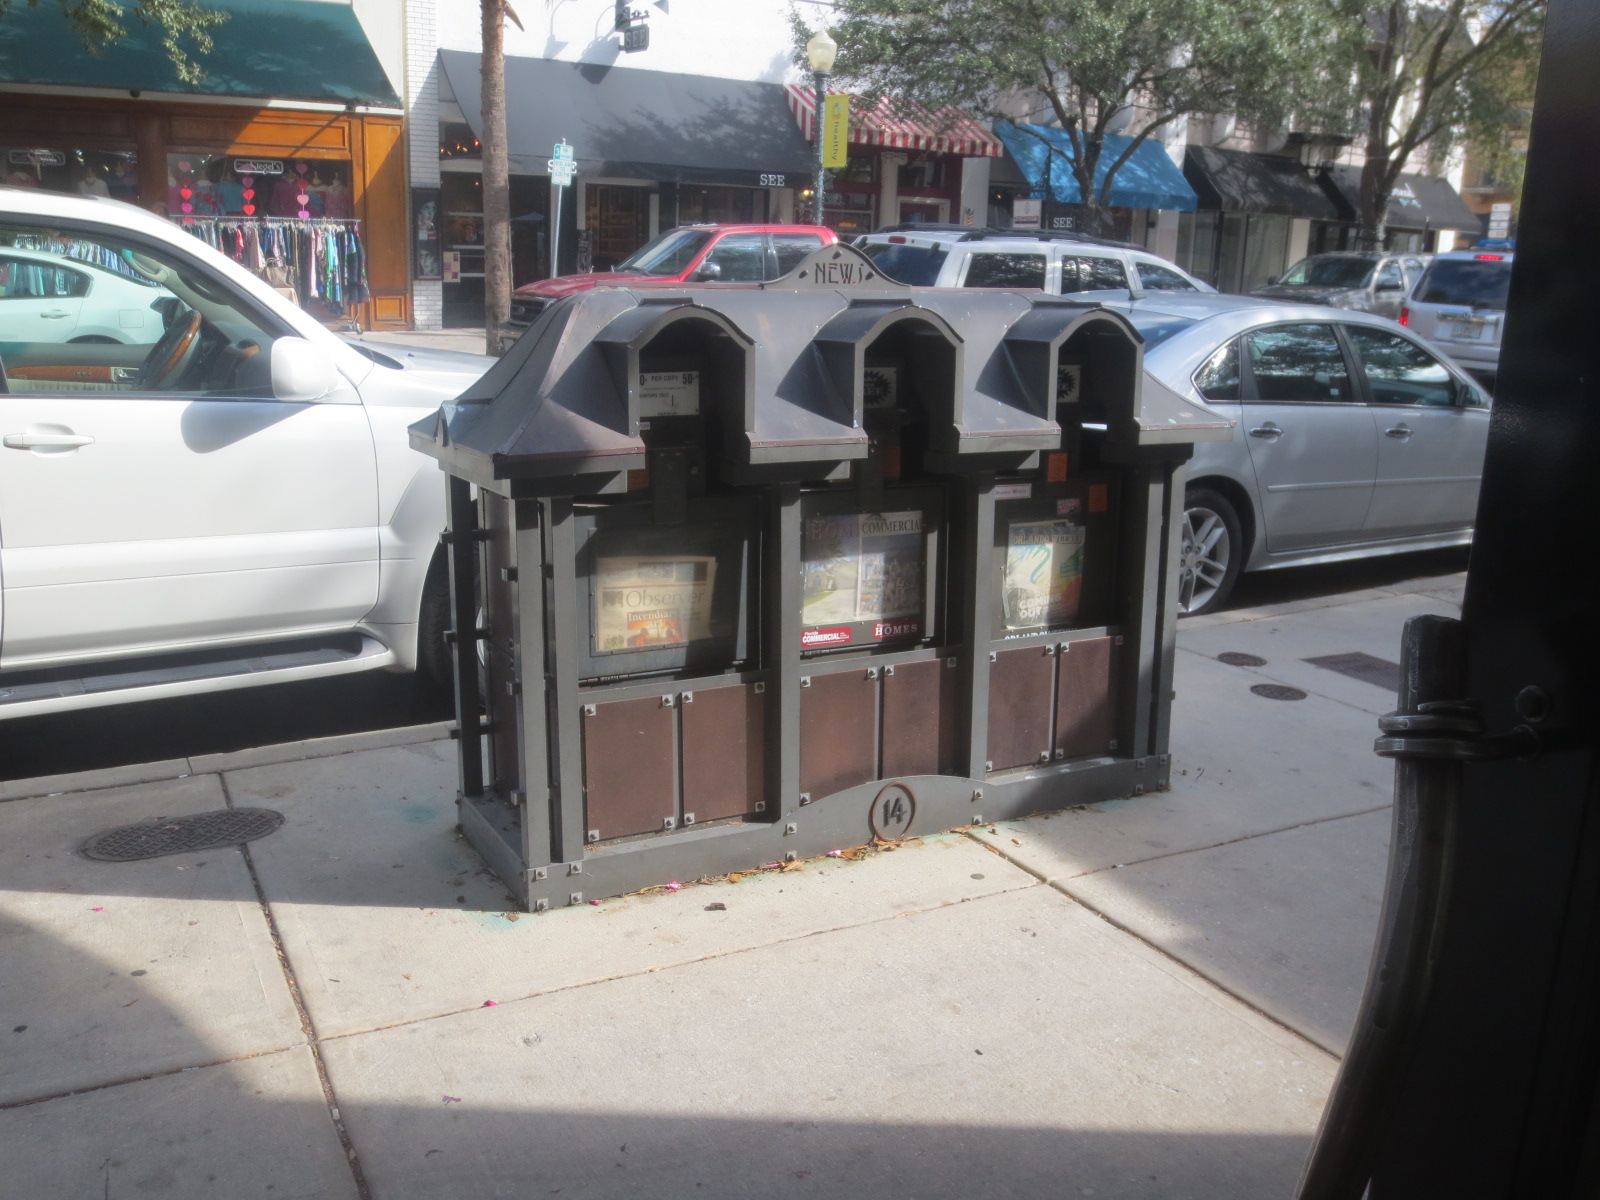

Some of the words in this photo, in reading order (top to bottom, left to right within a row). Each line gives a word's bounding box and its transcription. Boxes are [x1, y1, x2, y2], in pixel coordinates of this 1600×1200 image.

[625, 29, 646, 48] SEE
[832, 121, 840, 161] healthy
[760, 173, 785, 186] SEE
[1053, 217, 1073, 228] SEE
[815, 262, 864, 285] NEWS
[626, 589, 705, 607] Observer
[802, 632, 840, 643] COMMERCIAL
[875, 624, 918, 636] HOMES
[883, 797, 907, 827] 14
